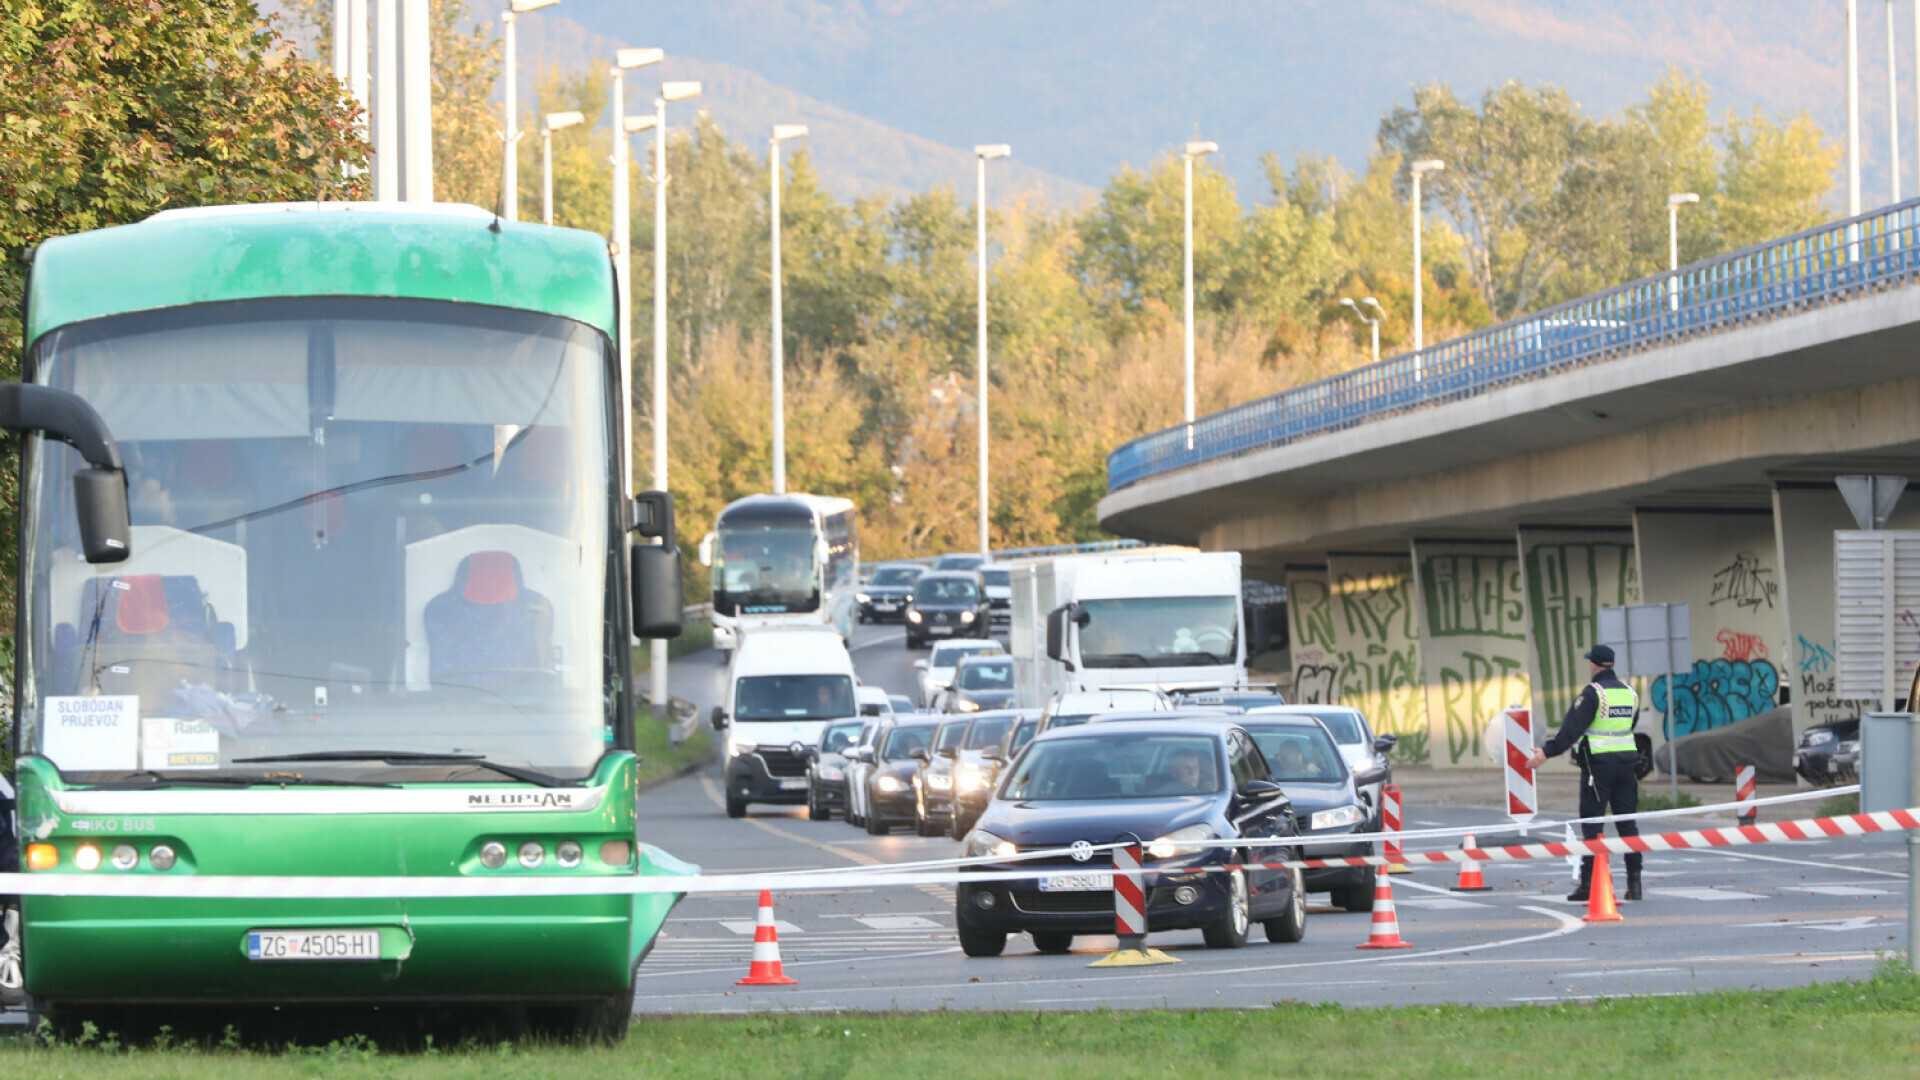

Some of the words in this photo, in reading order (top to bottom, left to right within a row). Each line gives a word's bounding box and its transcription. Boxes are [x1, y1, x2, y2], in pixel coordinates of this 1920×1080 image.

[1801, 674, 1835, 698] Mož
[58, 700, 124, 713] SLOBODAN
[61, 714, 119, 727] PRIJEVOZ
[468, 793, 571, 807] NEOPLAN
[123, 818, 155, 831] BUS
[263, 936, 286, 956] ZG
[300, 935, 372, 955] 4505-HI
